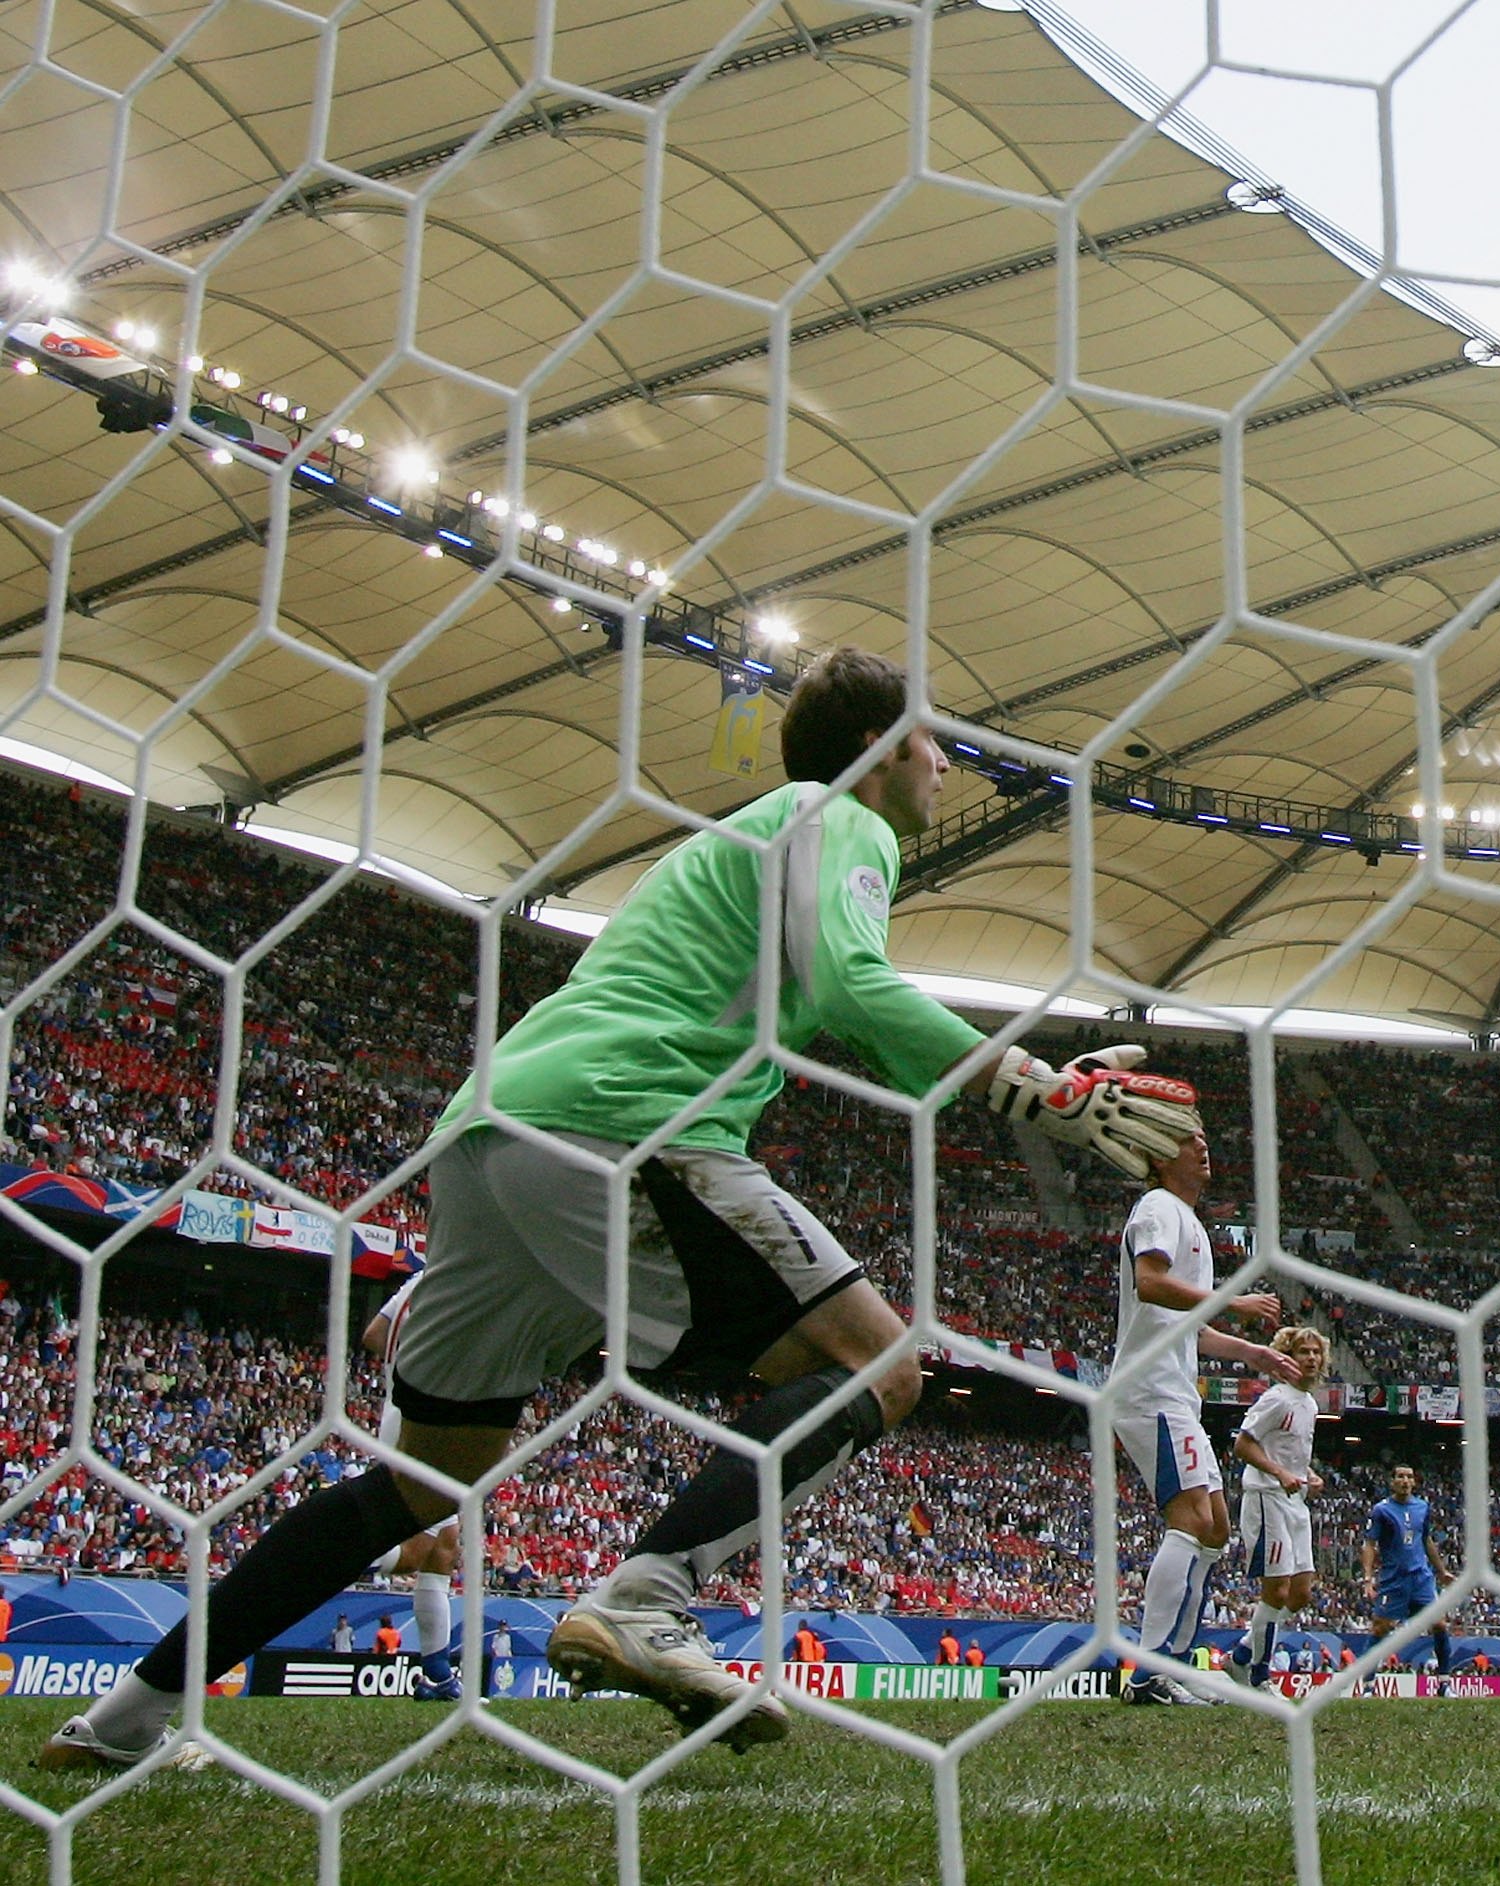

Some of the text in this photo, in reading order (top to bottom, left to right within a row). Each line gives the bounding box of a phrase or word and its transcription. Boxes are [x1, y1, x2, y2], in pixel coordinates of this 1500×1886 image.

[1184, 1436, 1198, 1472] 5
[14, 1655, 145, 1696] Master
[872, 1667, 982, 1700] FUJIFILM
